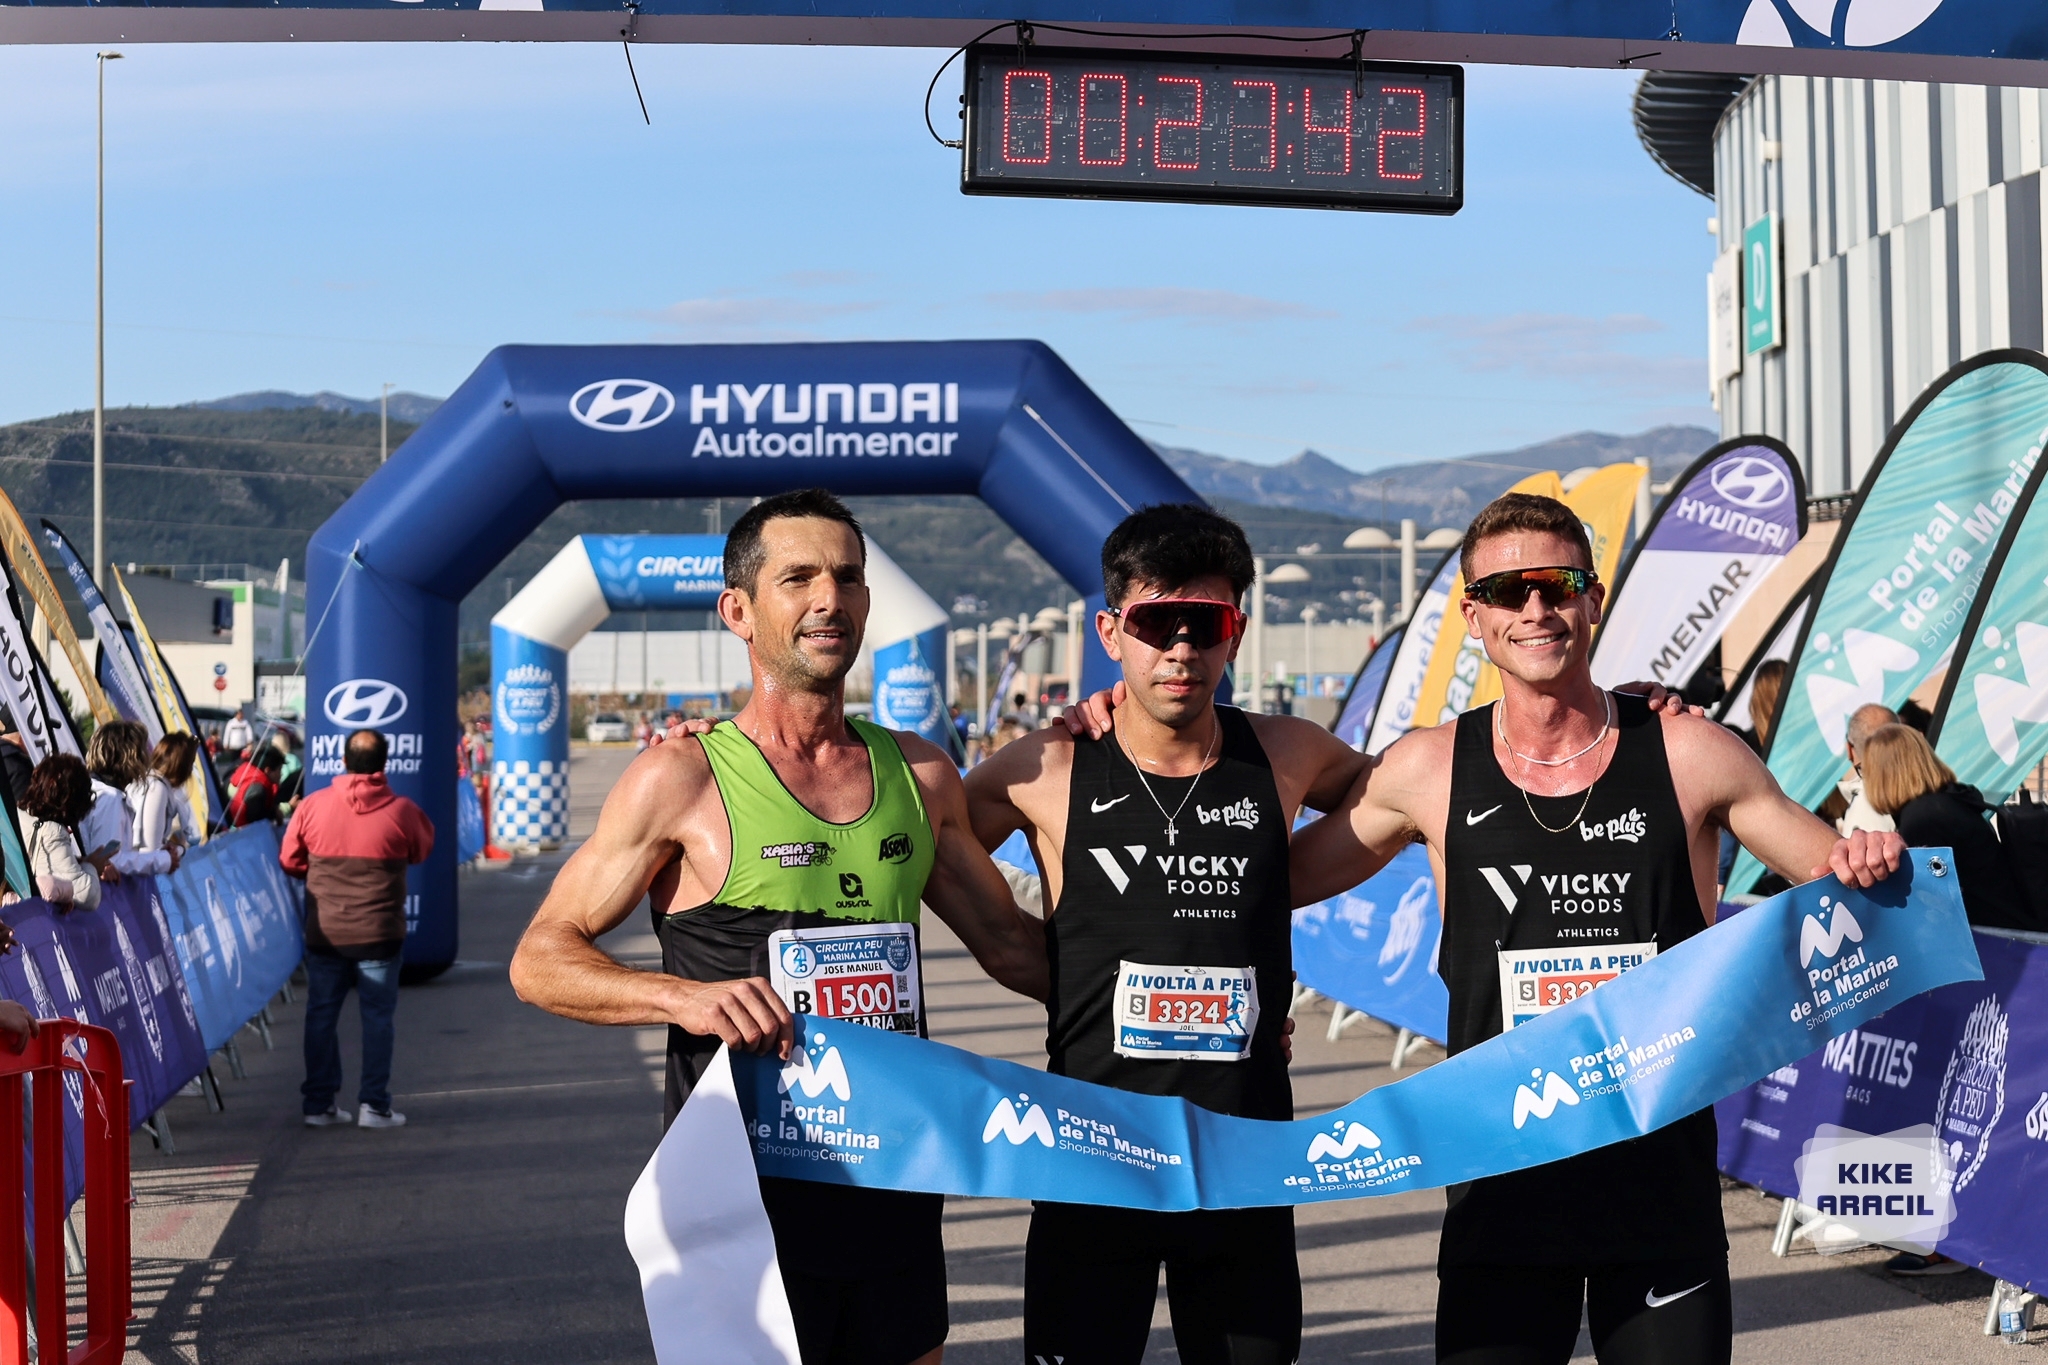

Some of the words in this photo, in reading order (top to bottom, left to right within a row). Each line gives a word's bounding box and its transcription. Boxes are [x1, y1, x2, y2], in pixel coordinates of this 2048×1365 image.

[690, 383, 959, 424] HYUNDAI
[691, 426, 959, 458] Autoalmenar
[1676, 497, 1789, 548] HYUNDAI
[1868, 500, 1960, 613] Portal
[1900, 586, 1940, 631] de
[1932, 546, 1973, 583] la
[312, 734, 423, 757] HYDAI
[1196, 804, 1221, 824] be
[1223, 797, 1260, 829] plus
[1579, 820, 1605, 841] be
[1606, 808, 1647, 843] plus
[781, 855, 811, 867] BIKE
[1156, 855, 1249, 877] VICKY
[1168, 879, 1240, 895] FOODS
[1540, 873, 1632, 895] VICKY
[1173, 909, 1237, 918] ATHLETICS
[1551, 898, 1623, 914] FOODS
[815, 942, 852, 953] CIRCUIT
[854, 941, 862, 950] A
[864, 939, 883, 949] PEU
[1557, 928, 1620, 938] ATHLETICS
[823, 952, 857, 962] MARINA
[859, 950, 880, 960] ALTA
[824, 964, 845, 975] JOSE
[846, 962, 883, 973] MANUEL
[1590, 956, 1602, 970] A
[1608, 955, 1643, 969] PEU
[1808, 946, 1866, 989] Portal
[822, 981, 892, 1017] 1500
[1202, 977, 1215, 991] A
[1220, 978, 1252, 992] PEU
[1790, 1001, 1812, 1022] de
[1813, 988, 1832, 1008] la
[1834, 954, 1899, 996] Marina
[794, 990, 812, 1014] B
[1157, 1000, 1221, 1024] 3324
[1806, 978, 1890, 1030] ShoppingCenter
[1569, 1035, 1630, 1074] Portal
[1577, 1069, 1603, 1088] de
[1606, 1062, 1626, 1079] la
[1627, 1025, 1696, 1068] Marina
[1822, 1029, 1918, 1089] MATTIES
[1583, 1053, 1676, 1100] ShoppingCenter
[1956, 1055, 2000, 1091] CIRCUIT
[1846, 1085, 1871, 1105] BAGS
[1949, 1085, 1962, 1113] A
[1961, 1085, 1987, 1121] PEU
[781, 1099, 845, 1125] Portal
[1057, 1108, 1117, 1136] Portal
[748, 1119, 771, 1138] de
[779, 1121, 798, 1140] la
[805, 1123, 880, 1149] Marina
[1059, 1124, 1084, 1140] de
[1090, 1131, 1108, 1147] la
[1114, 1138, 1182, 1165] Marina
[757, 1142, 864, 1164] ShoppingCenter
[1059, 1140, 1157, 1171] ShoppingCenter
[1314, 1150, 1383, 1173] Portal
[1283, 1175, 1312, 1186] de
[1317, 1173, 1339, 1184] la
[1345, 1155, 1422, 1181] Marina
[1301, 1168, 1411, 1192] ShoppingCenter
